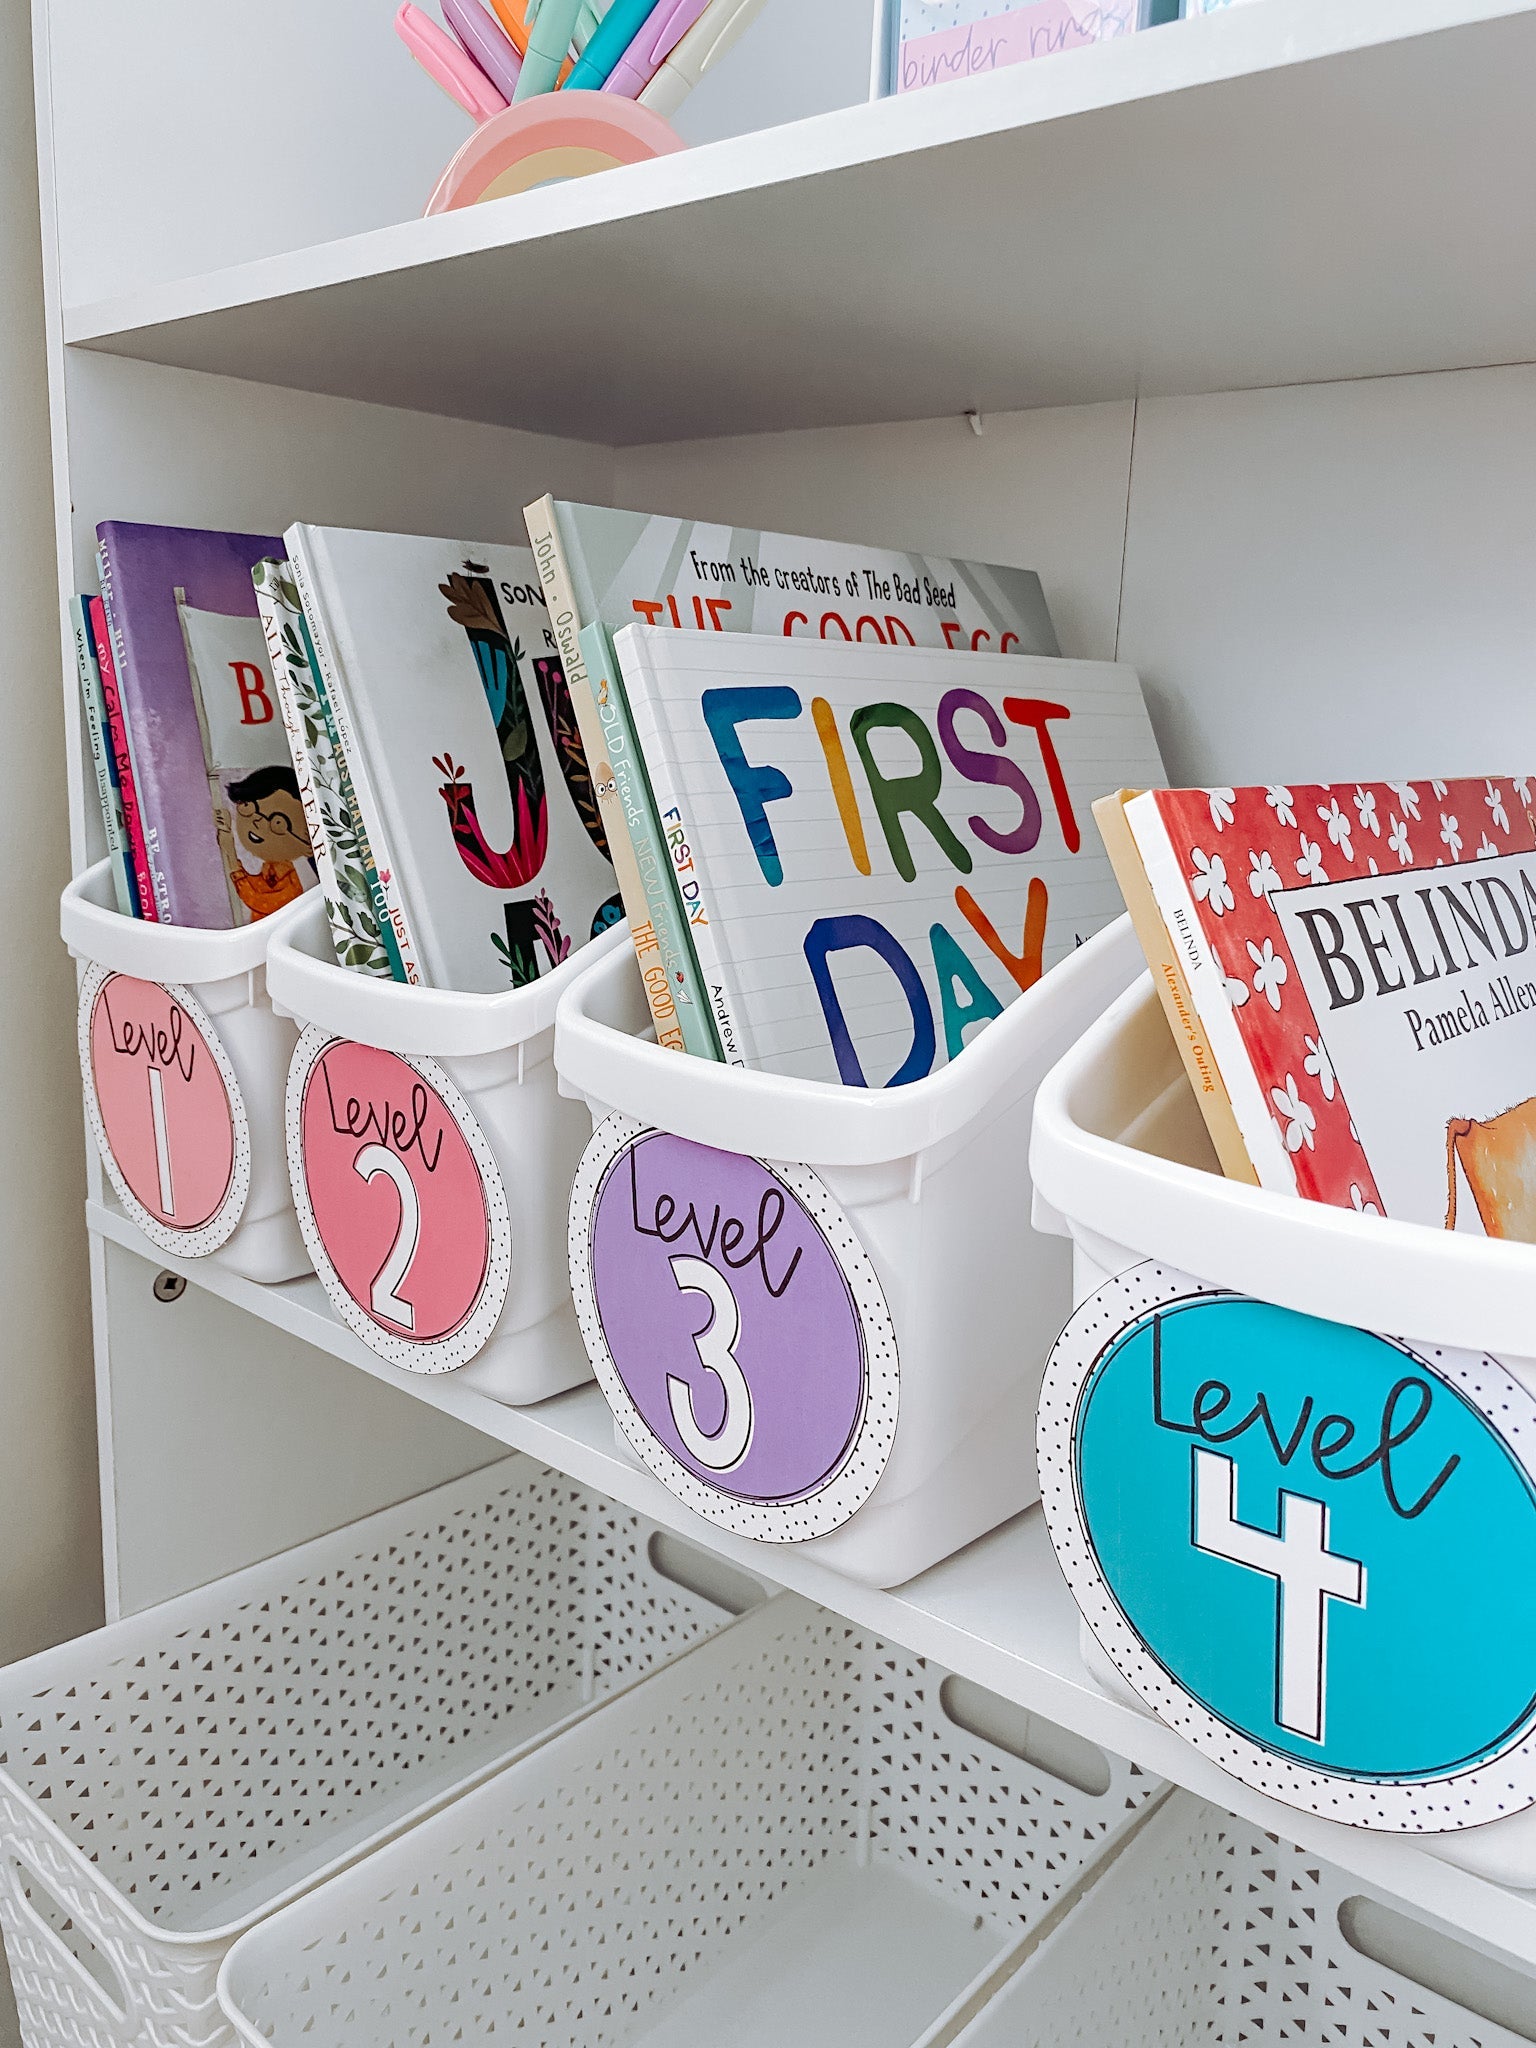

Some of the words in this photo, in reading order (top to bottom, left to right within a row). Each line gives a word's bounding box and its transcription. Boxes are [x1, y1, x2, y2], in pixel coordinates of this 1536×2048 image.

[902, 24, 1008, 88] binder
[292, 554, 305, 589] Sonia
[302, 592, 325, 658] Sotomayor
[325, 671, 341, 713] Rafael
[338, 716, 353, 755] López
[534, 530, 556, 585] John
[556, 611, 588, 684] Oswald
[690, 550, 736, 584] From
[740, 557, 769, 588] the
[774, 565, 841, 597] creators
[845, 571, 859, 598] of
[862, 569, 891, 601] The
[893, 573, 920, 605] Bad
[924, 577, 957, 609] Seed
[76, 627, 87, 671] When
[88, 705, 101, 761] Feeling
[98, 768, 119, 852] Disappointed
[104, 685, 120, 742] Calm
[262, 614, 282, 671] ALL
[301, 774, 327, 863] YEAR
[701, 686, 1081, 888] FIRST
[333, 742, 377, 873] AUSTRALIAN
[599, 703, 625, 754] OLD
[613, 758, 641, 828] Friends
[634, 837, 664, 896] NEW
[650, 901, 678, 970] Friends
[388, 906, 410, 950] JUST
[632, 920, 660, 960] THE
[643, 966, 676, 1020] GOOD
[662, 806, 695, 873] FIRST
[681, 880, 709, 927] DAY
[711, 984, 738, 1055] Andrew
[803, 876, 1049, 1089] DAY
[1172, 908, 1203, 971] BELINDA
[102, 989, 195, 1083] Level
[1160, 962, 1197, 1042] Alexander's
[1192, 1045, 1215, 1093] Outing
[1403, 989, 1491, 1052] Pamela
[147, 1065, 176, 1218] 1
[322, 1059, 443, 1173] Level
[352, 1141, 420, 1332] 2
[630, 1143, 803, 1298] Level
[666, 1253, 754, 1474] 3
[1153, 1313, 1461, 1520] Level
[1190, 1443, 1367, 1745] 4
